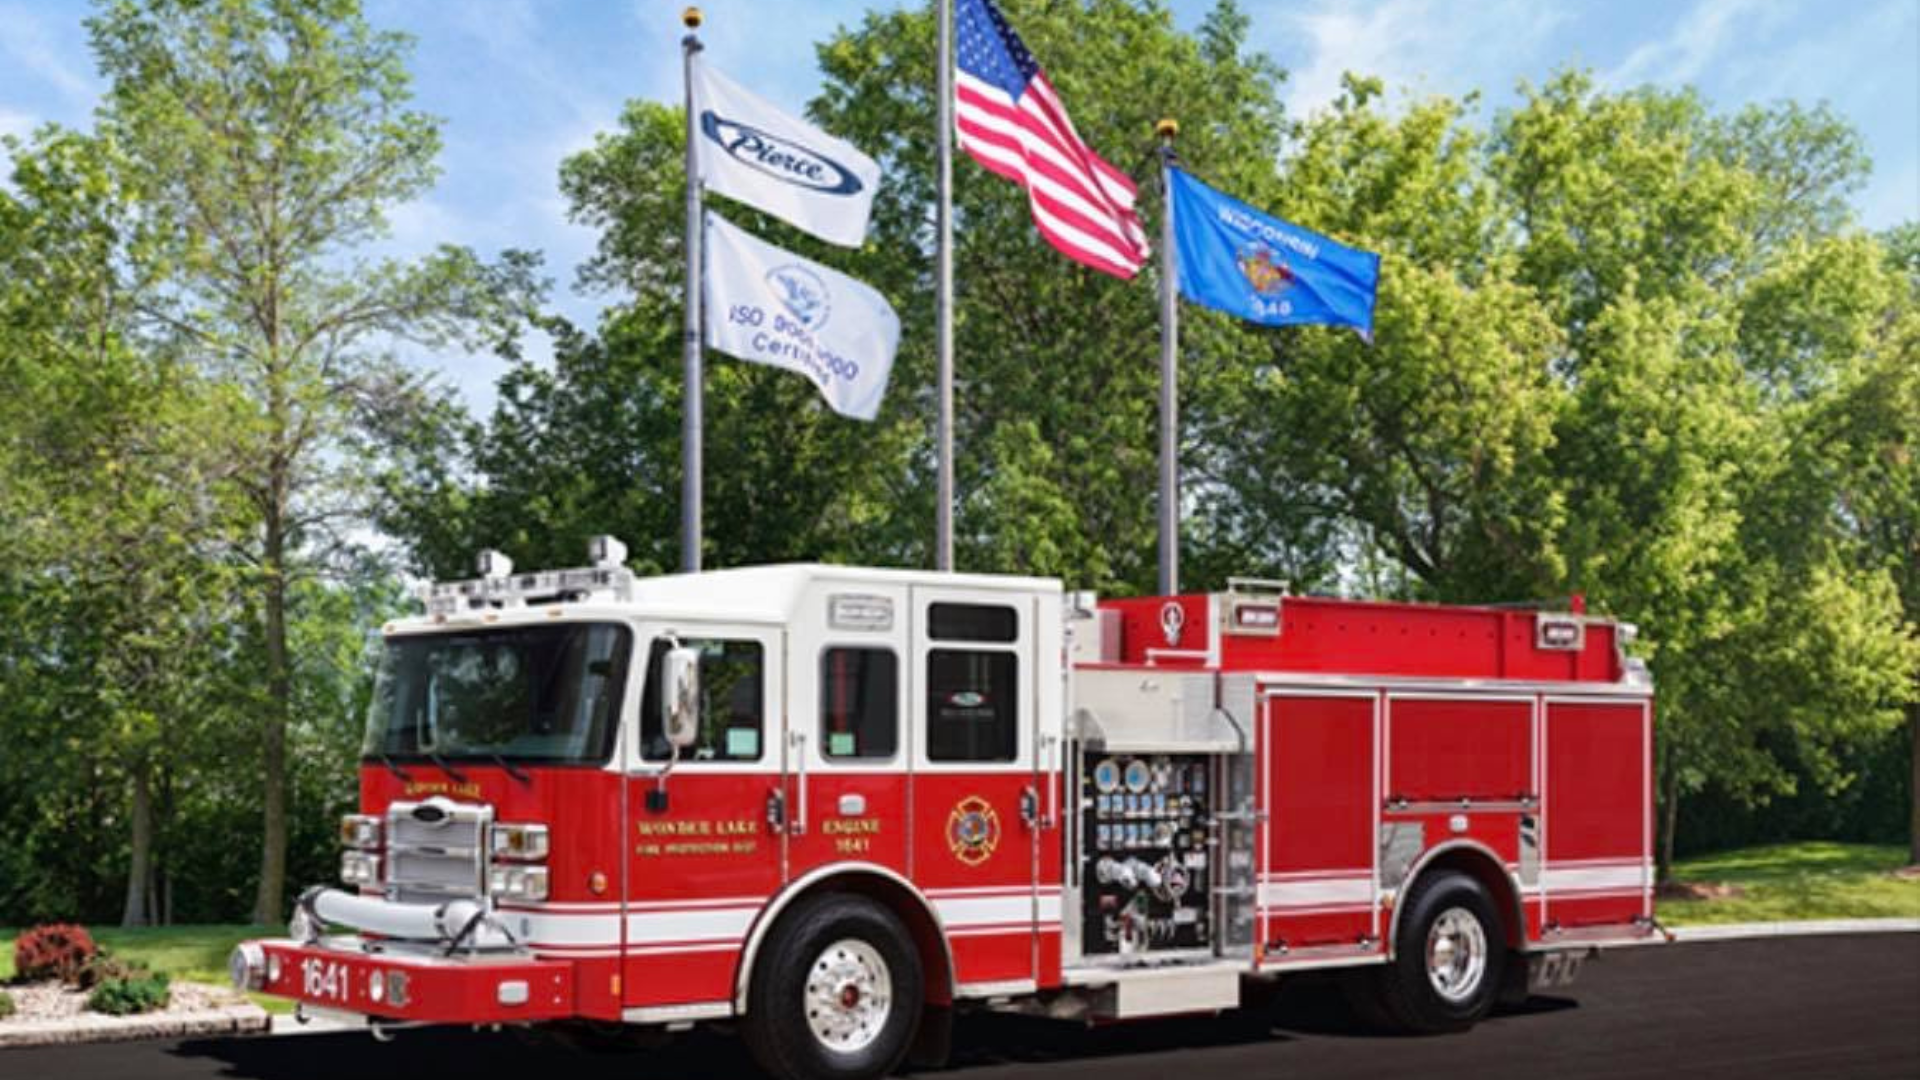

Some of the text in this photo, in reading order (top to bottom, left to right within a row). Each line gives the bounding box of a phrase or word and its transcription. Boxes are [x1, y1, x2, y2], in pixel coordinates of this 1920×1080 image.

[729, 134, 825, 181] Pierce
[729, 304, 764, 327] ISO
[637, 820, 757, 836] WONDER LAKE
[822, 819, 880, 835] ENGINE
[835, 838, 870, 853] 1641
[300, 957, 349, 1002] 1641
